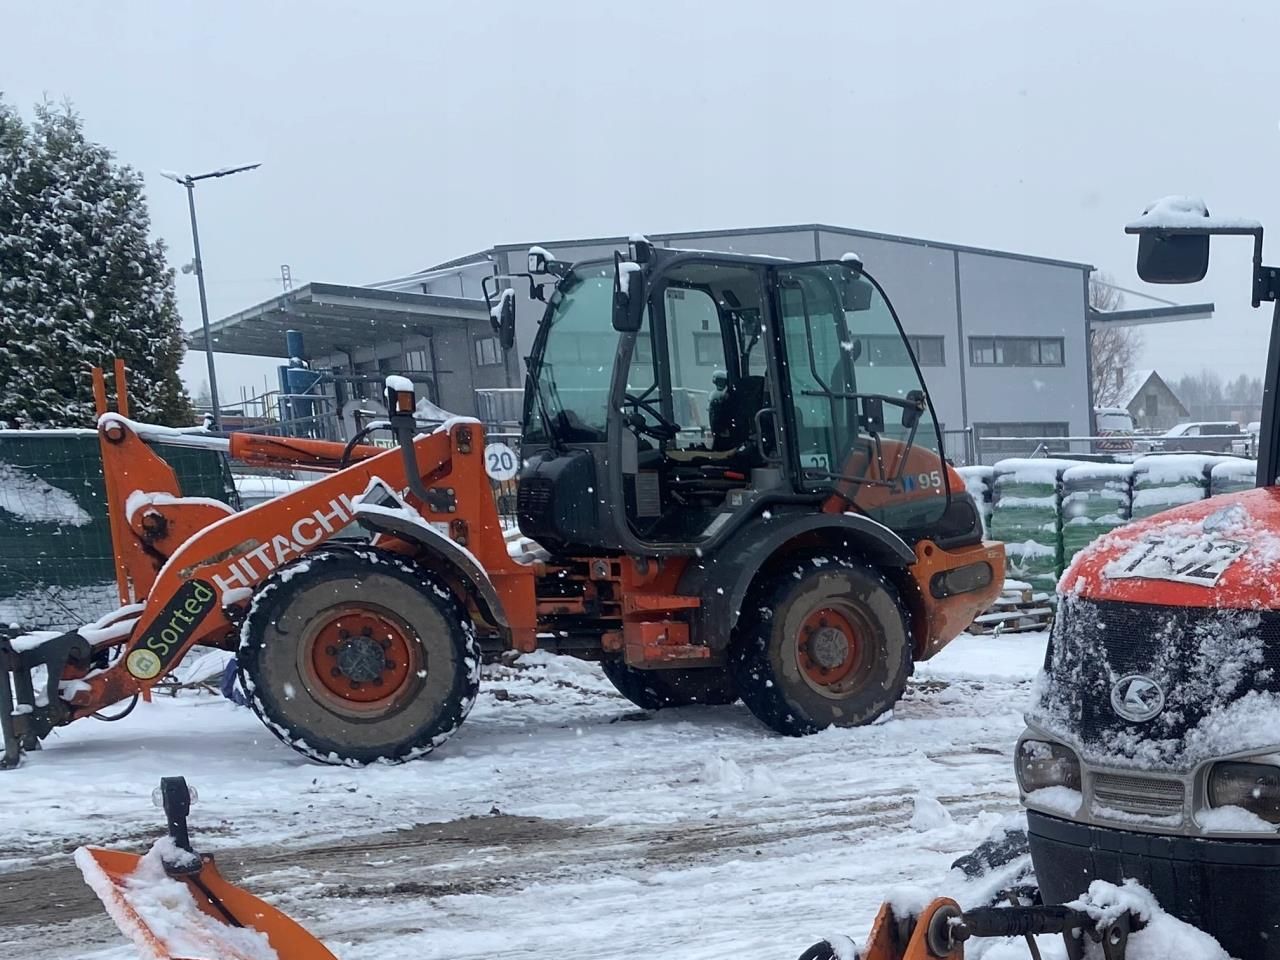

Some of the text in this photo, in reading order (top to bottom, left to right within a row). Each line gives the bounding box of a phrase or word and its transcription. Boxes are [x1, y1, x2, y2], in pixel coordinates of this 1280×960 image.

[488, 452, 513, 472] 20
[212, 494, 353, 592] HITACHI
[147, 581, 213, 656] Sorted
